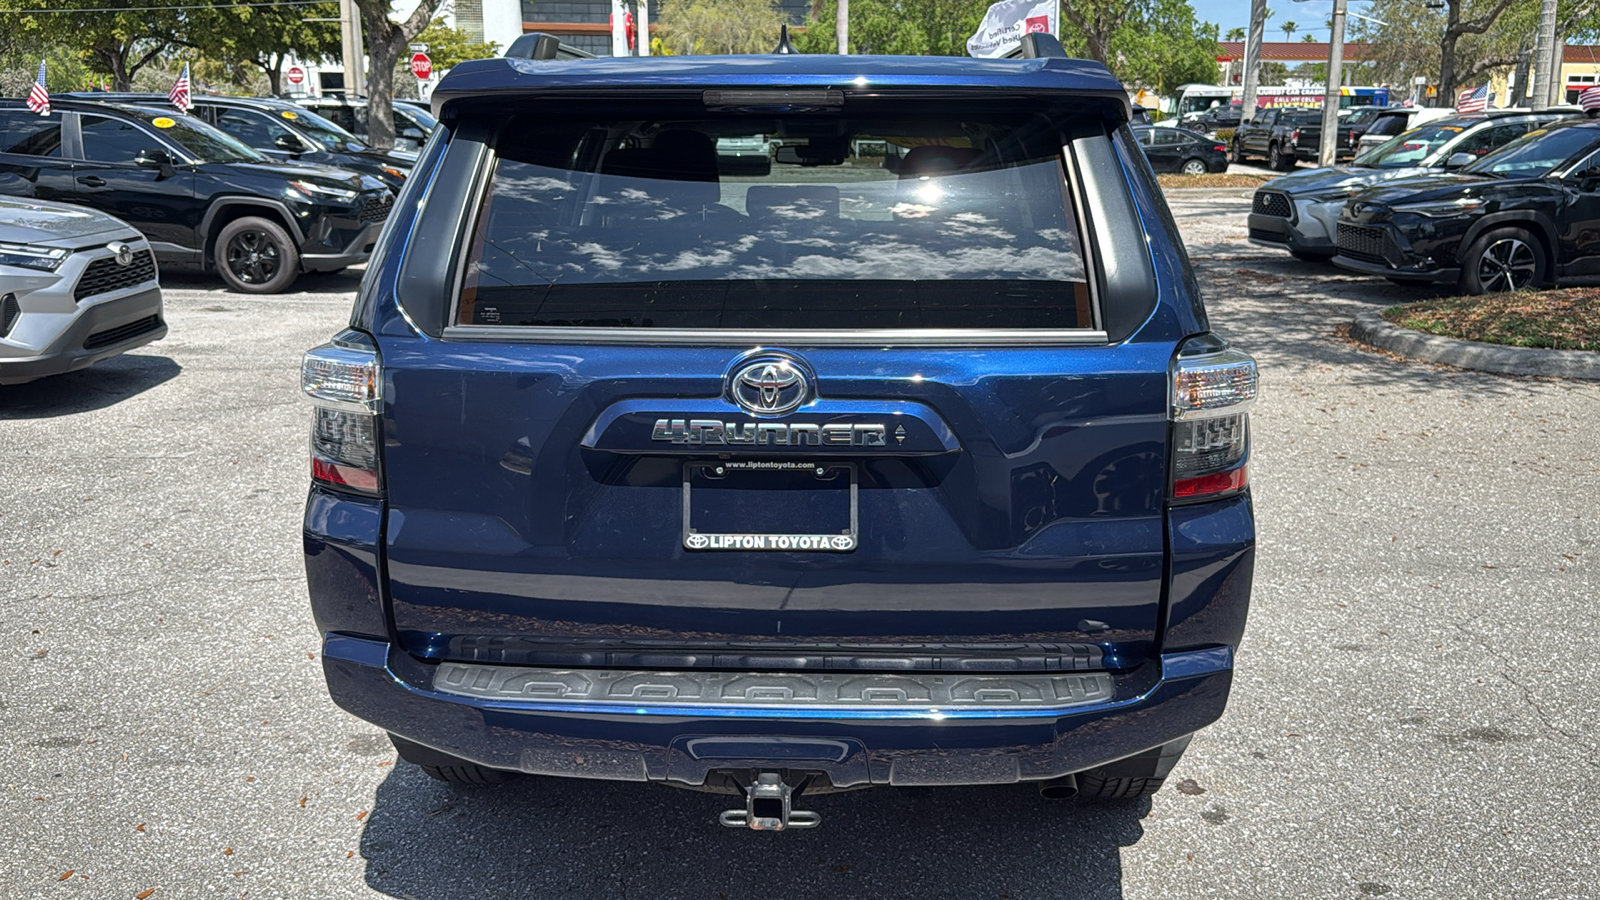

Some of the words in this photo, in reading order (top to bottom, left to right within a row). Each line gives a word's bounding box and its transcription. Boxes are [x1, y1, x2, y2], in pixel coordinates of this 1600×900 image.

[412, 61, 431, 72] STOP
[725, 461, 815, 470] www.liptontoyota.com
[710, 535, 765, 549] LIPTON
[768, 536, 831, 549] TOYOTA
